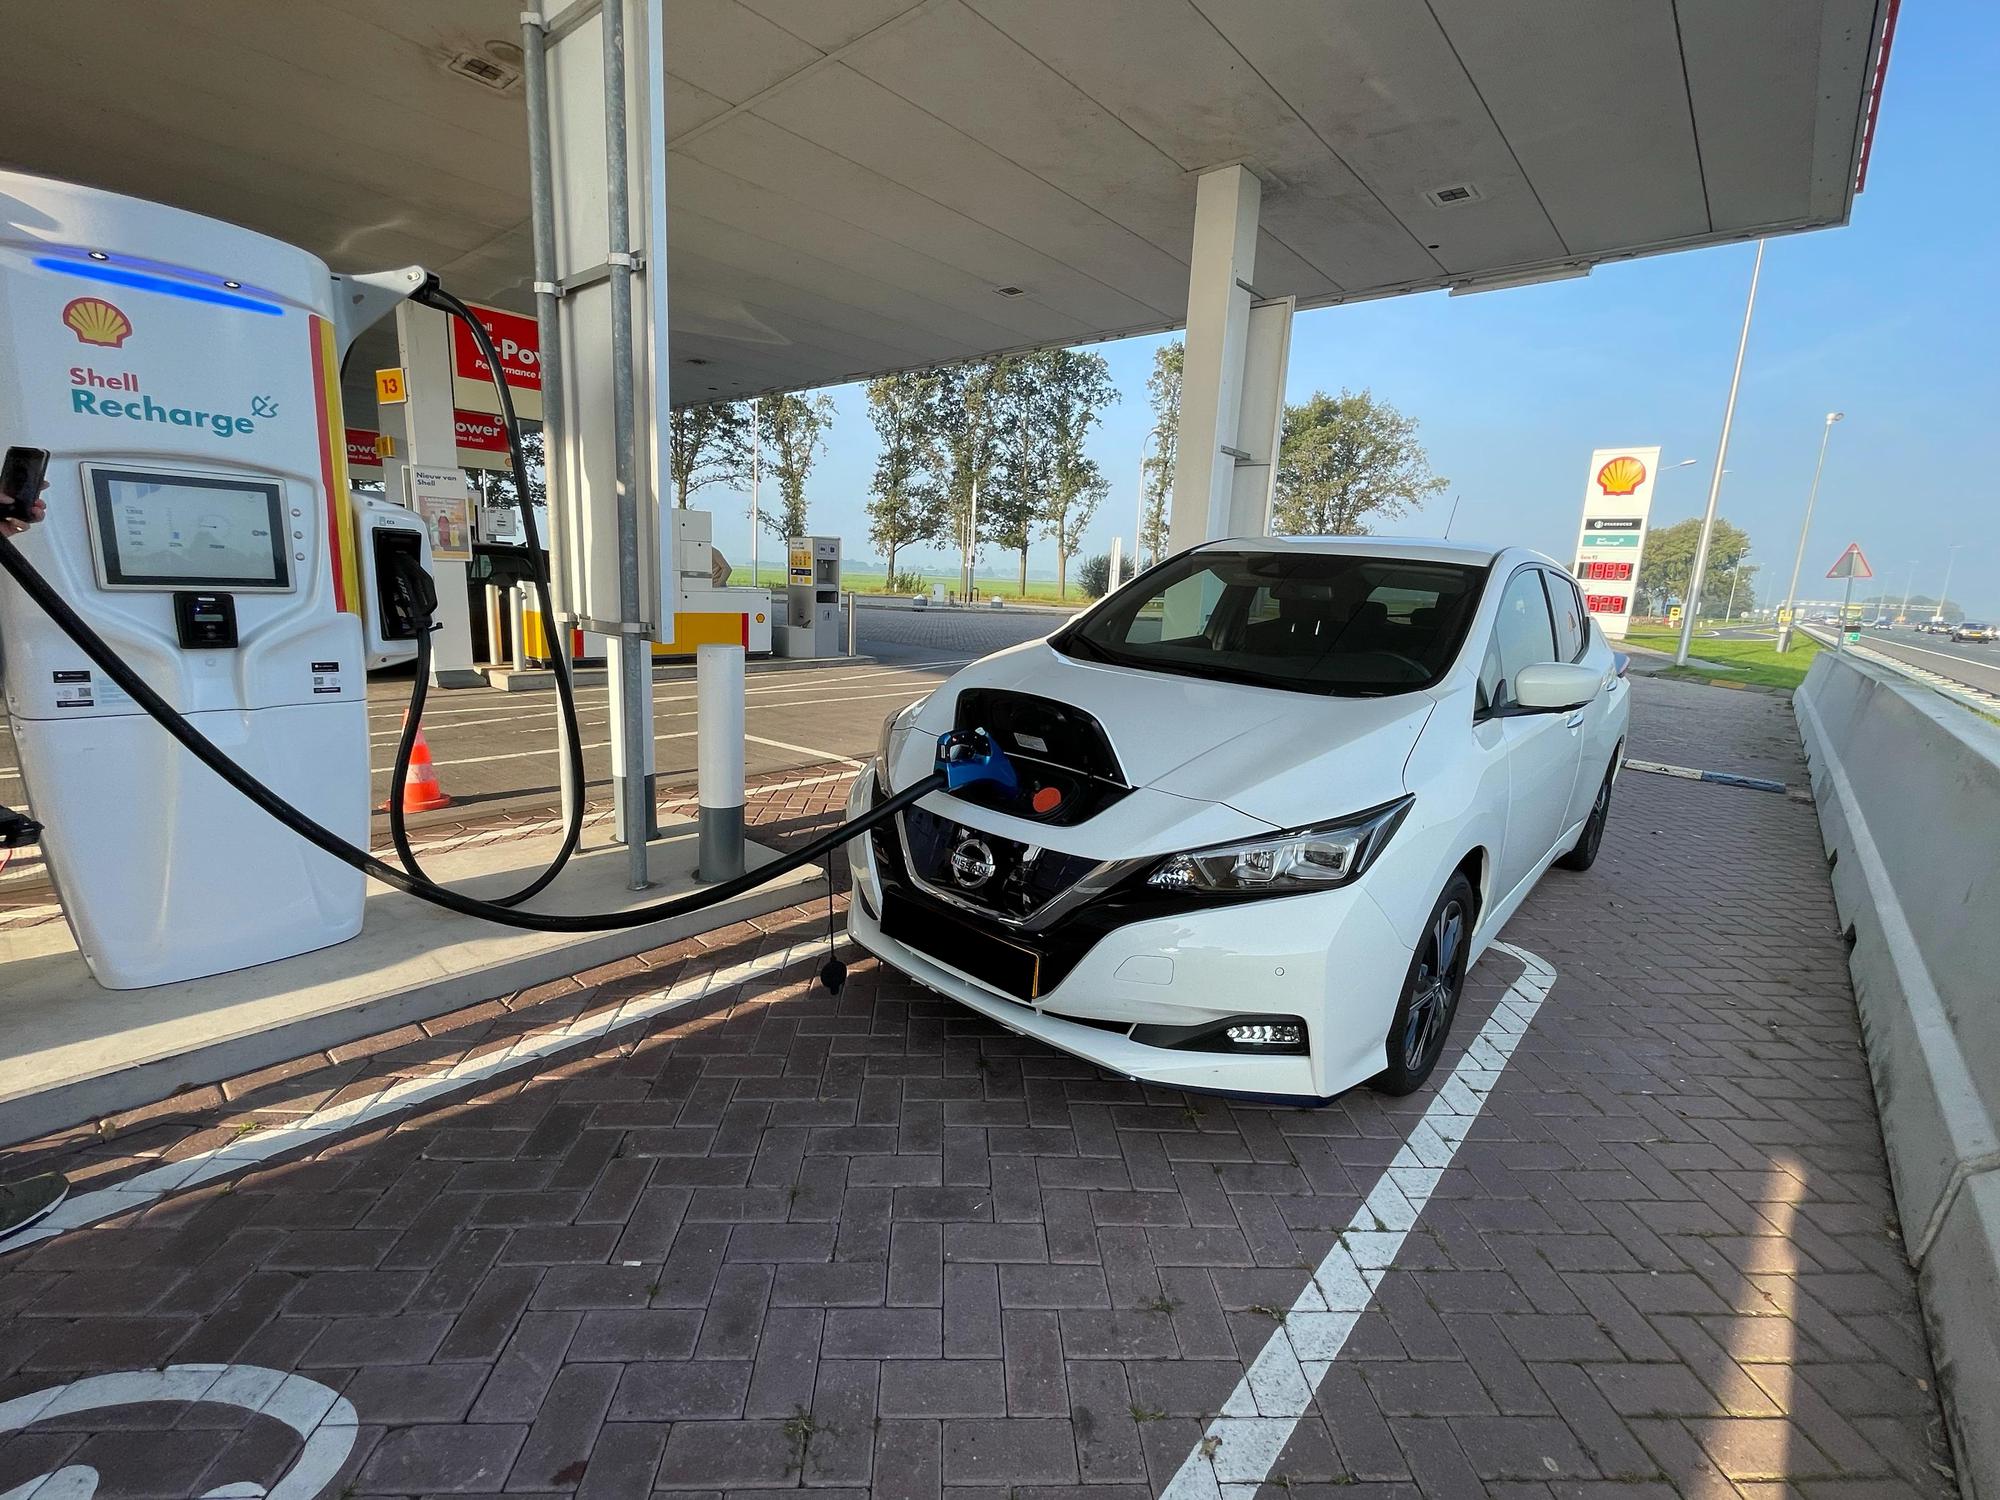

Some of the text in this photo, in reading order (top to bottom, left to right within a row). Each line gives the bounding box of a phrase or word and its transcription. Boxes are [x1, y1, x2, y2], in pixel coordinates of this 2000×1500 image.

[70, 367, 139, 392] Shell
[382, 378, 398, 394] 13
[71, 388, 254, 438] Recharge
[416, 472, 441, 480] Nieuw
[417, 479, 436, 487] Shell
[1585, 595, 1623, 613] 629
[952, 853, 990, 877] NISSAN
